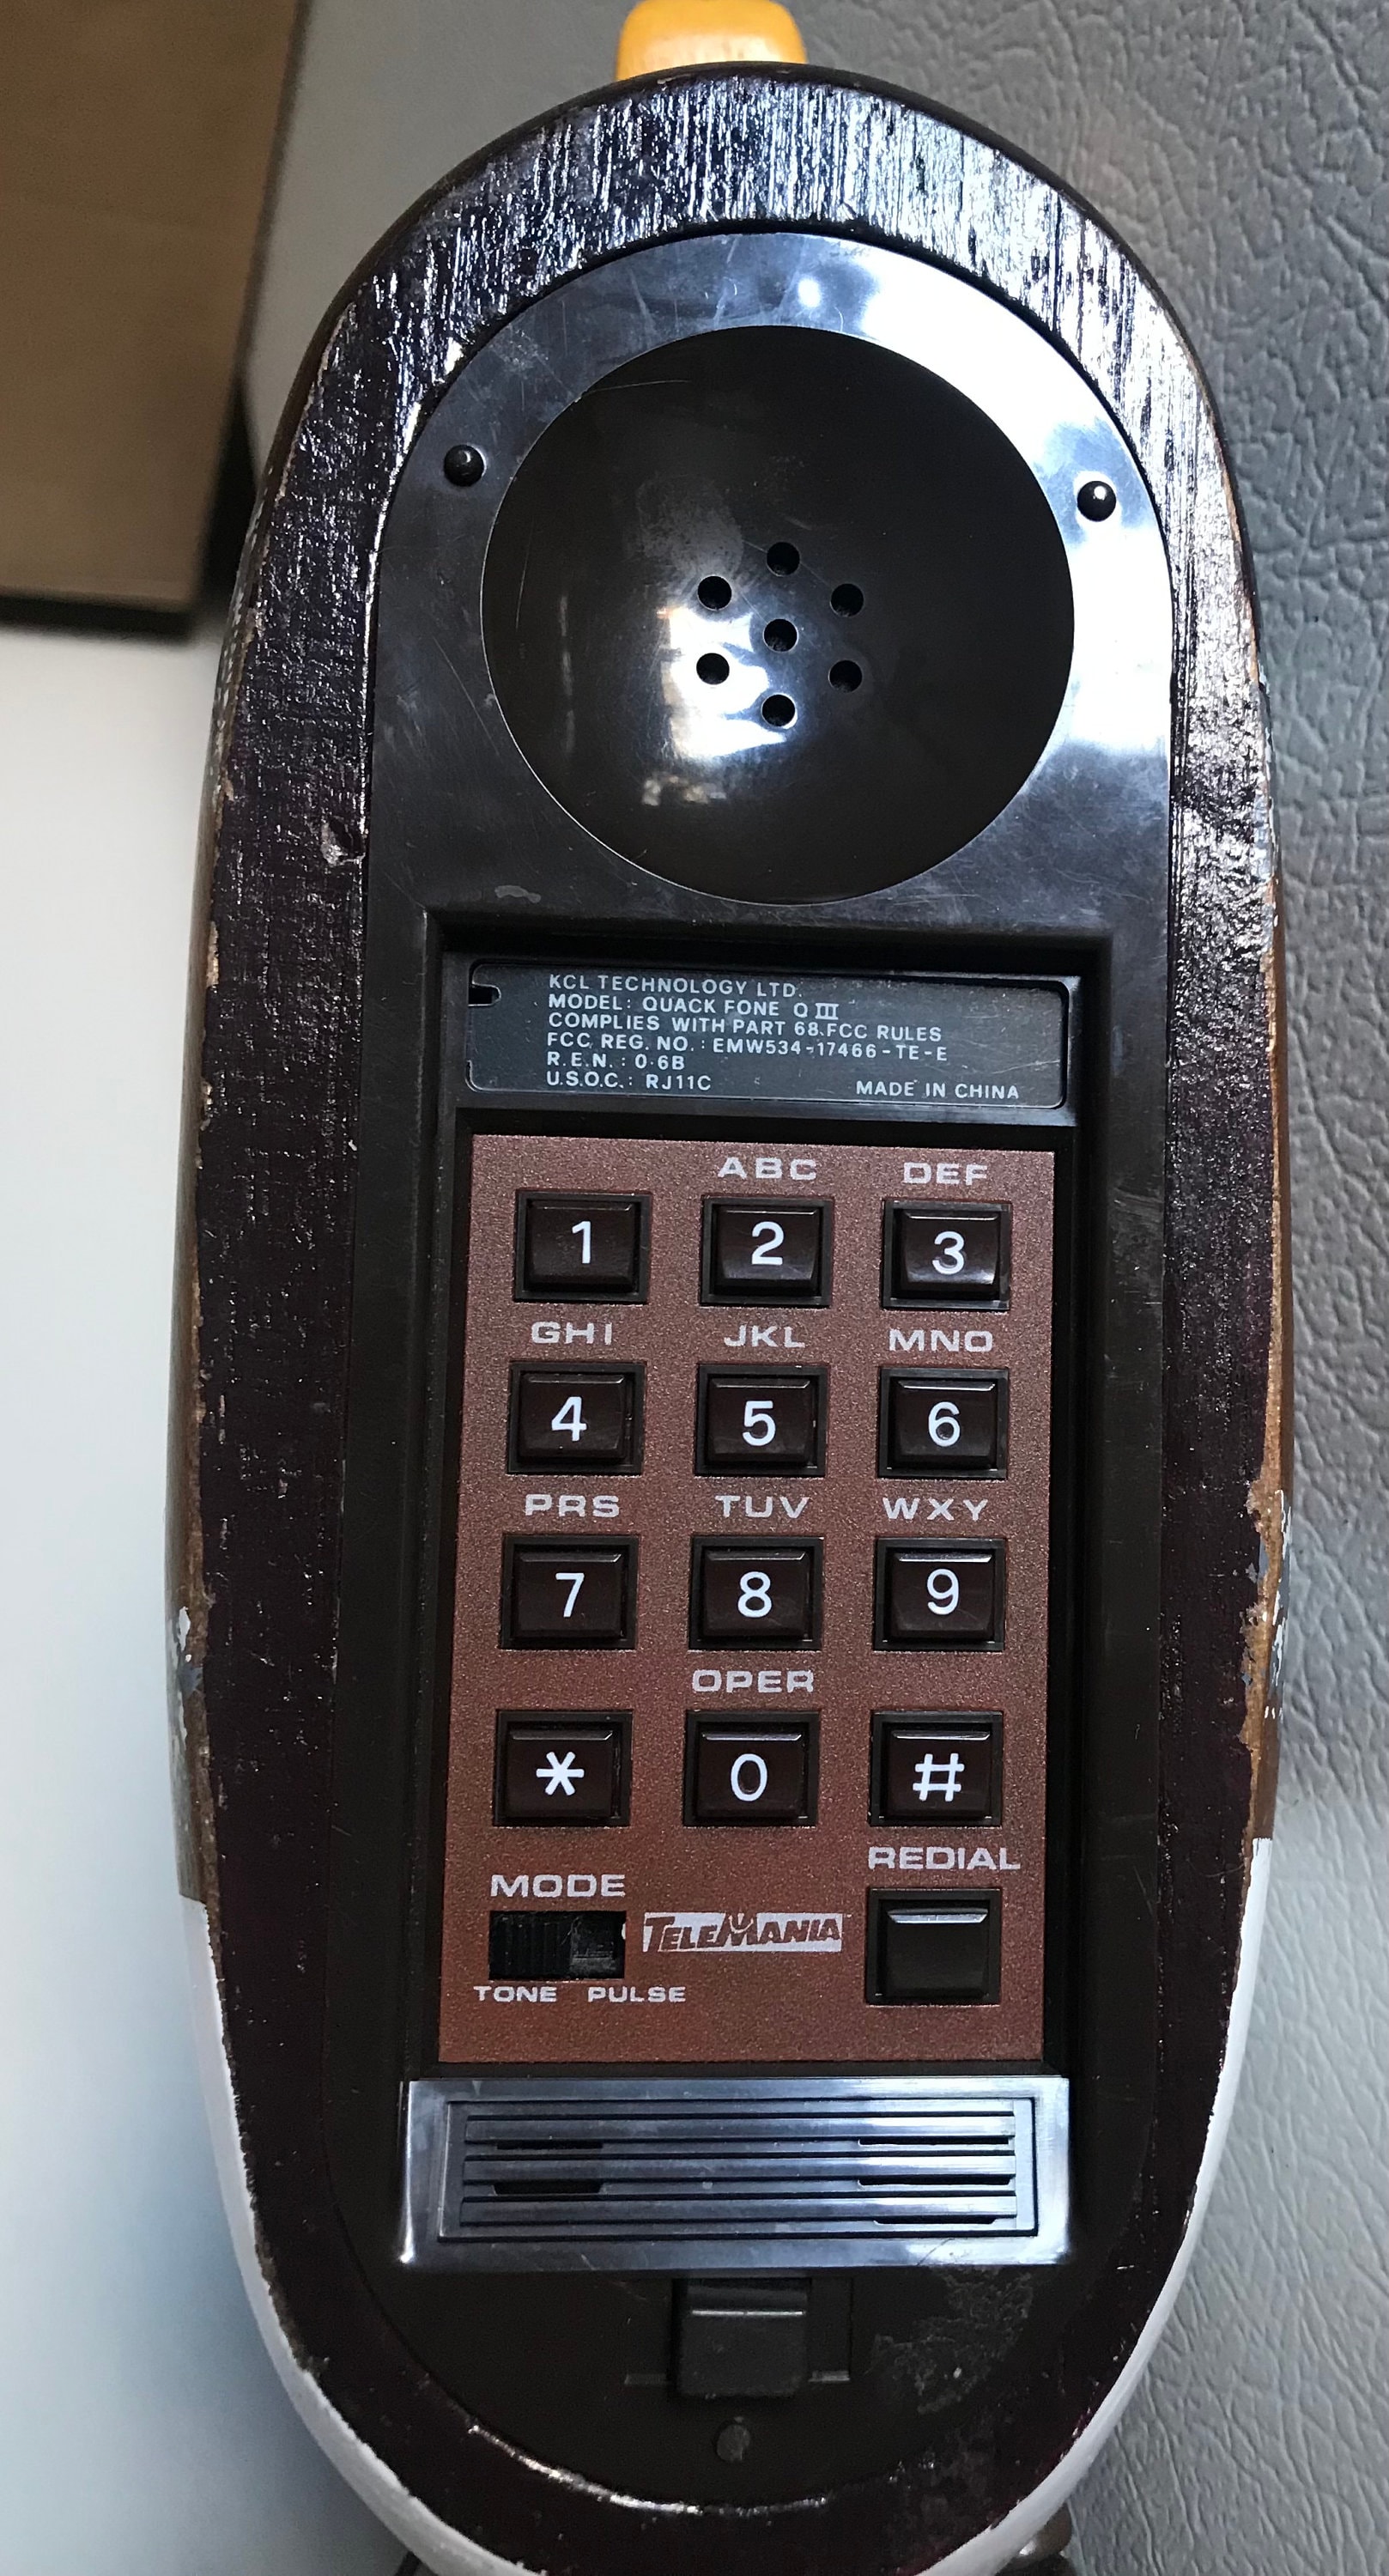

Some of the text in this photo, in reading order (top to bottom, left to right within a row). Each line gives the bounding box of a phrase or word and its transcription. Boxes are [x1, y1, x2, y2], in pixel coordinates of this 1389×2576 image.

[550, 975, 804, 997] KCL TECHNOLOGY LTD.
[643, 997, 716, 1013] QUACK
[725, 1000, 779, 1016] FONE
[549, 1012, 659, 1030] COMPLIES
[672, 1018, 725, 1032] WITH
[733, 1019, 785, 1035] PART
[877, 1025, 941, 1042] RULES
[548, 1032, 592, 1048] FCC
[602, 1034, 648, 1050] REG.
[646, 1074, 711, 1090] RJ11C
[857, 1081, 1018, 1099] MADE IN CHINA
[718, 1157, 818, 1180] ABC
[901, 1163, 987, 1185] DEF
[573, 1221, 591, 1263] 1
[752, 1222, 784, 1265] 2
[931, 1230, 966, 1274] 3
[531, 1321, 612, 1345] GHI
[724, 1325, 805, 1347] JKL
[889, 1328, 993, 1353] MNO
[552, 1397, 586, 1441] 4
[743, 1401, 775, 1445] 5
[929, 1402, 960, 1446] 6
[523, 1494, 619, 1517] PRS
[715, 1496, 810, 1518] TUV
[883, 1497, 988, 1522] WXY
[555, 1573, 584, 1617] 7
[738, 1571, 772, 1617] 8
[927, 1569, 958, 1614] 9
[692, 1669, 814, 1692] OPER
[913, 1753, 964, 1801] #
[868, 1846, 1020, 1870] REDIAL
[491, 1874, 625, 1898] MODE
[474, 1986, 685, 2002] TONE PULSE
